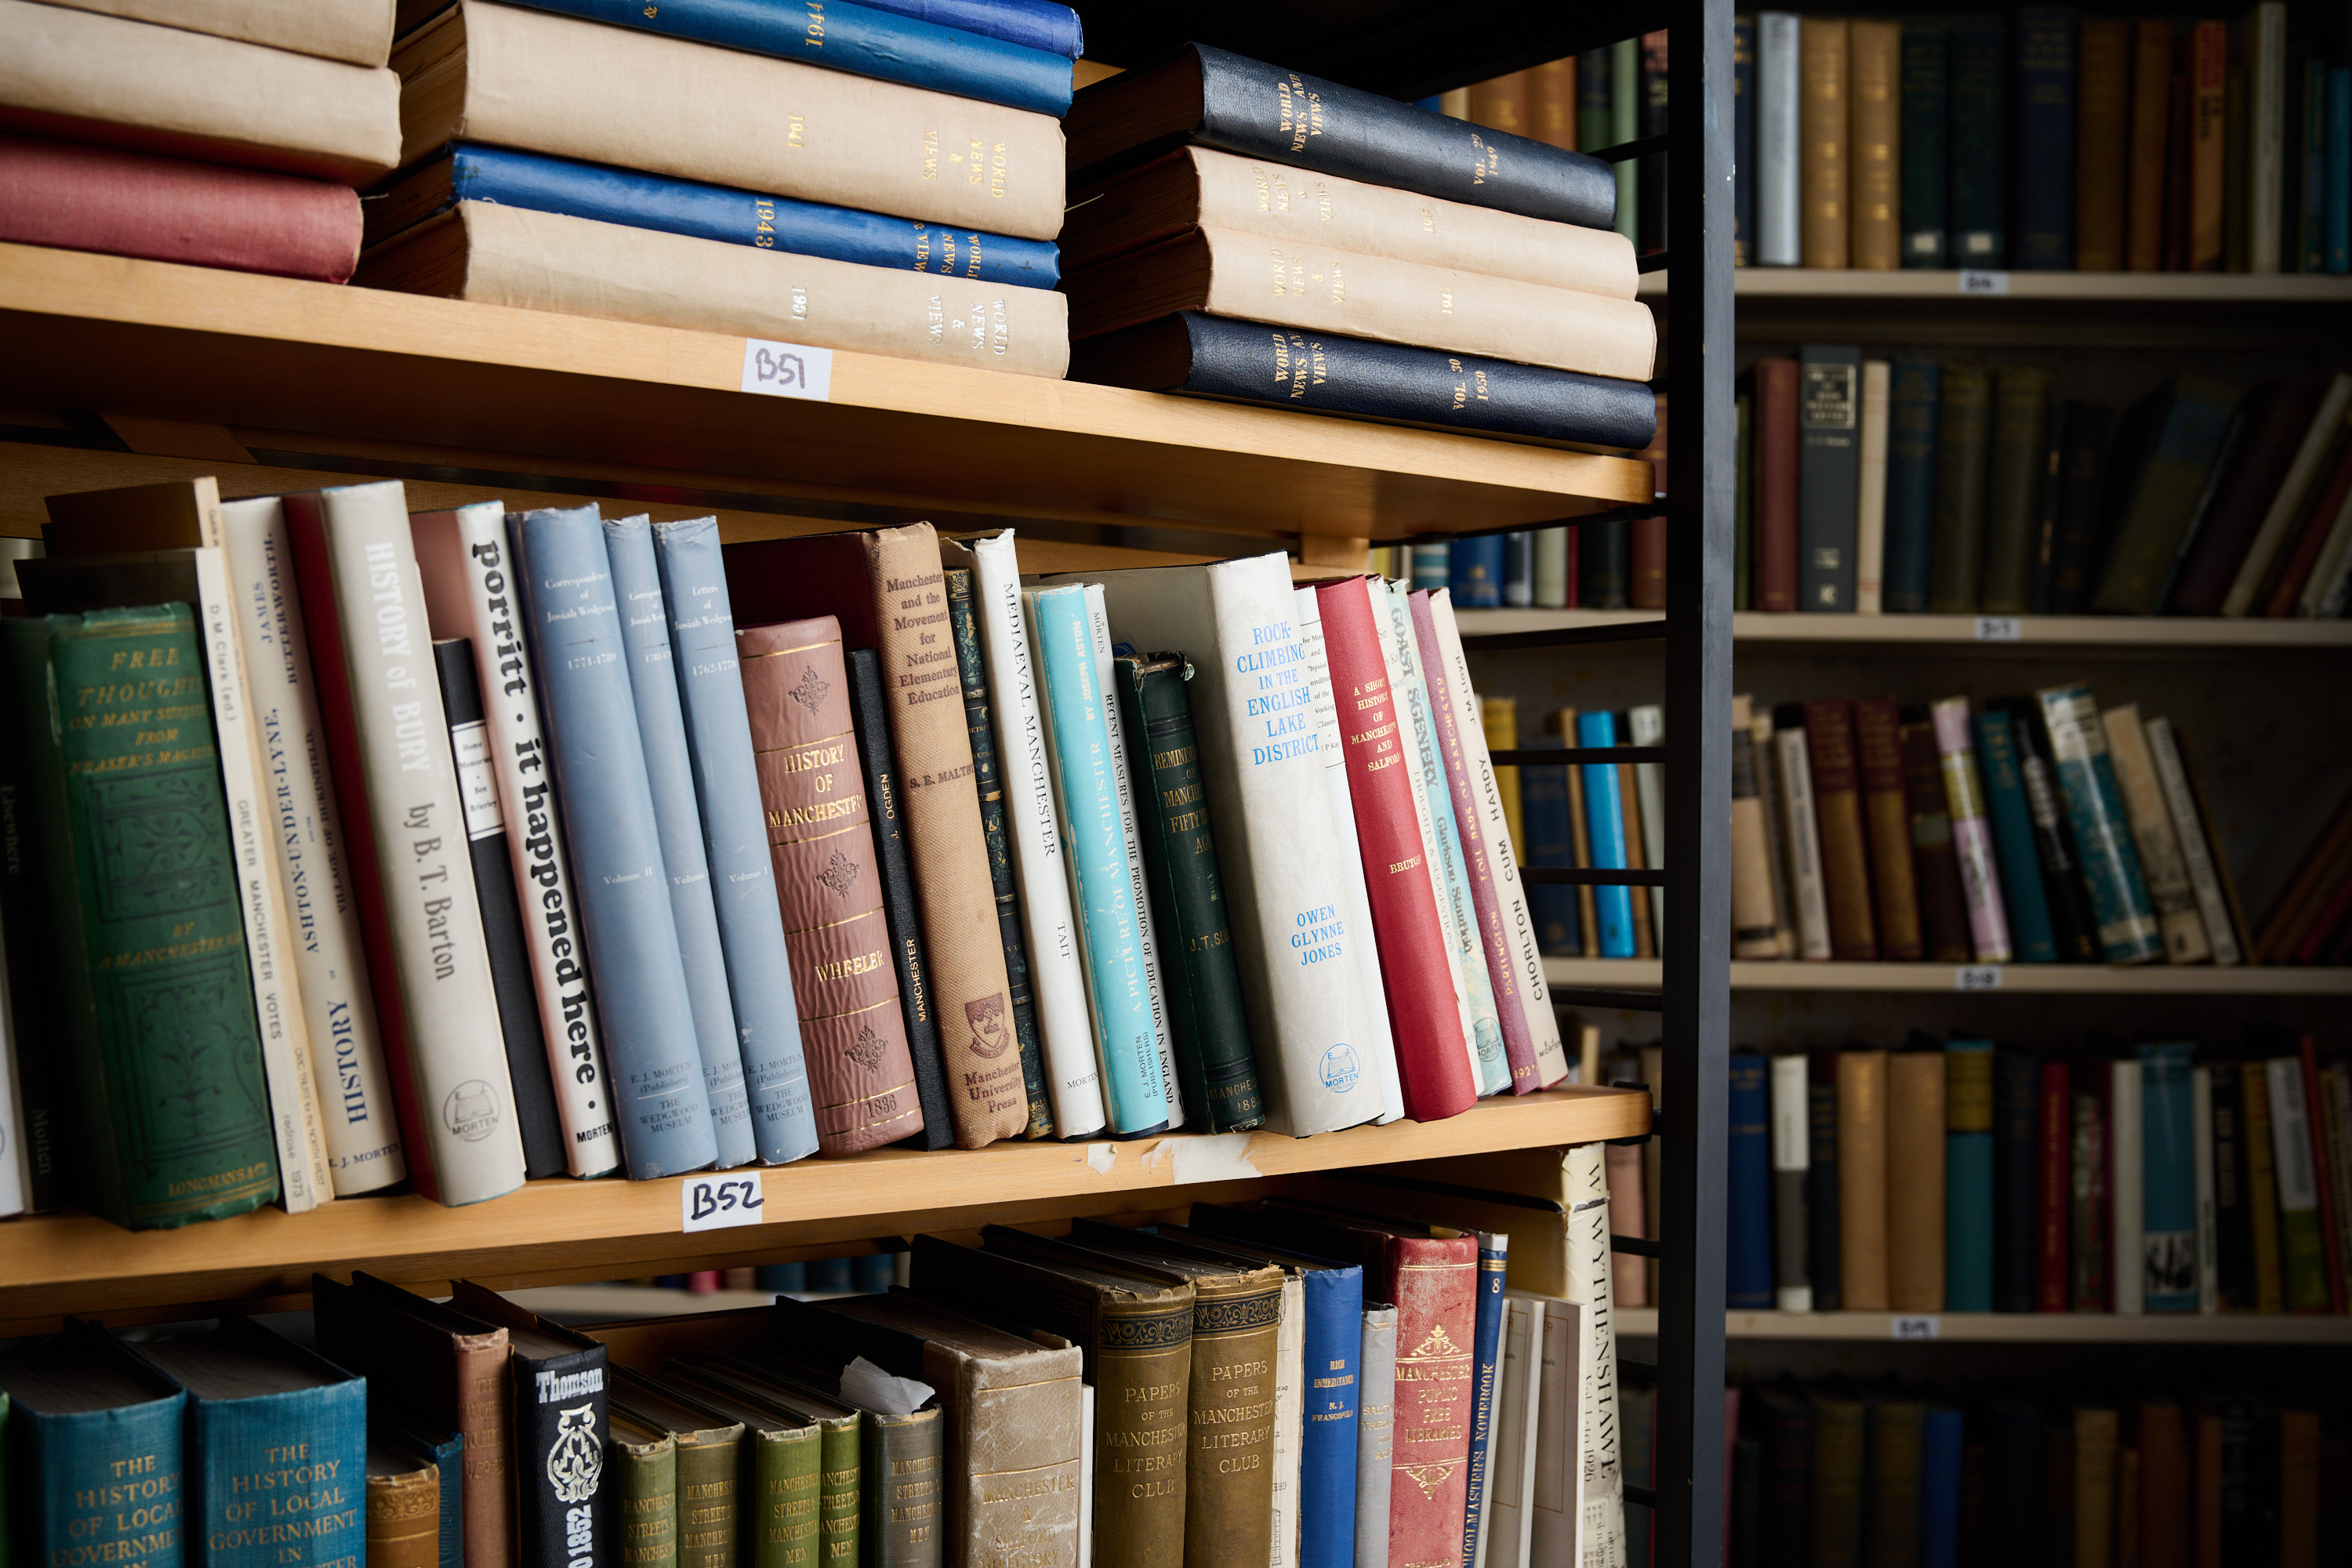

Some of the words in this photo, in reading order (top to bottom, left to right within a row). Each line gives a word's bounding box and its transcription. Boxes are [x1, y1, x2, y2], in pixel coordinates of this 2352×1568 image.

[805, 2, 826, 49] 1944
[1288, 72, 1306, 98] AND
[1279, 82, 1293, 132] WORLD
[1307, 92, 1322, 136] VIEWS
[1290, 112, 1308, 154] NEWS
[922, 130, 938, 182] VIEWS
[949, 152, 964, 163] &
[970, 138, 984, 186] NEWS
[991, 142, 1006, 199] WORLD
[1252, 165, 1272, 214] WORLD
[1277, 172, 1291, 212] NEWS
[755, 199, 775, 249] 1943
[940, 232, 956, 274] NEWS
[1271, 248, 1286, 297] WORLD
[1292, 255, 1306, 298] NEWS
[1311, 271, 1325, 282] &
[1332, 260, 1346, 305] VIEWS
[1440, 285, 1454, 314] 1947
[928, 295, 943, 347] VIEWS
[953, 319, 966, 329] &
[971, 302, 985, 350] NEWS
[992, 299, 1007, 355] WORLD
[755, 347, 806, 390] B51
[1274, 332, 1289, 383] WORLD
[1310, 342, 1327, 386] VIEWS
[1290, 358, 1308, 399] NEWS
[1475, 370, 1490, 401] 1950
[691, 585, 719, 597] Letters
[885, 572, 943, 593] Manchester
[252, 582, 272, 644] JAMES
[365, 541, 413, 657] HISTORY
[901, 596, 922, 610] and
[926, 591, 942, 605] the
[472, 540, 528, 699] porritt
[893, 609, 949, 631] Movement
[1093, 612, 1105, 655] MORTEN
[919, 631, 937, 646] for
[1073, 620, 1087, 658] ASTON
[1310, 648, 1321, 657] and
[110, 646, 180, 670] FREE
[692, 659, 737, 677] 1762-1770
[906, 648, 953, 667] National
[1236, 642, 1306, 674] CLIMBING
[386, 665, 418, 691] of
[898, 666, 959, 688] Elementary
[1078, 660, 1094, 702] JOSEPH
[1258, 675, 1273, 691] IN
[1275, 668, 1300, 687] THE
[1353, 686, 1361, 696] A
[907, 684, 961, 706] Education
[1247, 686, 1312, 717] ENGLISH
[1314, 691, 1321, 700] of
[1390, 606, 1416, 678] COAST
[1406, 686, 1440, 789] SCENERY
[100, 709, 153, 728] MANY
[1105, 693, 1120, 739] RECENT
[1266, 712, 1307, 739] LAKE
[1317, 717, 1336, 728] Classes
[1373, 710, 1384, 722] OF
[391, 701, 432, 774] BURY
[1253, 733, 1320, 766] DISTRICT
[1376, 739, 1393, 754] AND
[514, 737, 543, 776] it
[785, 744, 844, 775] HISTORY
[1003, 581, 1028, 709] MEDIAEVAL
[1024, 714, 1057, 857] MANCHESTER
[1056, 920, 1072, 960] TAIT
[815, 773, 834, 793] OF
[1112, 743, 1130, 806] MEASURES
[880, 772, 897, 819] OGDEN
[1089, 741, 1124, 880] MANCHESTER
[1123, 811, 1134, 834] FOR
[1169, 810, 1201, 834] FIFTY
[1126, 837, 1138, 863] THE
[1388, 853, 1422, 875] BRUTON
[1413, 768, 1435, 844] THOUGHTS
[1431, 861, 1455, 953] SUGGESTIONS
[1497, 838, 1515, 883] CUM
[522, 781, 583, 988] happened
[603, 871, 641, 886] Volume
[728, 869, 762, 884] Volume
[1436, 815, 1457, 884] Clarkson
[1450, 885, 1473, 955] Stanfield
[404, 802, 436, 829] by
[424, 896, 456, 982] Barton
[1112, 885, 1128, 910] OF
[1131, 866, 1150, 938] PROMOTION
[237, 799, 259, 867] GREATER
[249, 880, 273, 982] MANCHESTER
[265, 992, 282, 1040] VOTES
[1296, 903, 1337, 928] OWEN
[1142, 941, 1153, 958] OF
[1290, 921, 1345, 949] GLYNNE
[1300, 942, 1343, 967] JONES
[1489, 910, 1513, 996] PARTINGTON
[1512, 899, 1544, 1002] CHORLTON
[815, 949, 885, 983] WHEELER
[906, 938, 928, 1023] MANCHESTER
[1145, 961, 1163, 1029] EDUCATION
[561, 988, 596, 1086] here
[1156, 1032, 1167, 1046] IN
[328, 1000, 368, 1125] HISTORY
[768, 1052, 803, 1069] MORTEN
[1135, 1035, 1148, 1077] MORTEN
[1142, 1031, 1158, 1098] (PUBLISHERS)
[1159, 1049, 1175, 1105] ENGLAND
[1325, 1073, 1359, 1088] MORTEN
[755, 1093, 809, 1114] WEDGWOOD
[774, 1087, 794, 1100] THE
[864, 1094, 898, 1120] 1836
[987, 1098, 1018, 1114] Press
[766, 1105, 804, 1123] MUSEUM
[575, 1121, 614, 1144] MORTEN
[290, 1171, 305, 1198] 1973
[691, 1181, 764, 1220] B52
[1491, 1277, 1501, 1294] 8
[1589, 1214, 1619, 1480] WYTHENSHAWE
[1210, 1359, 1269, 1382] PAPERS
[1312, 1374, 1355, 1388] INHERITANCE
[1394, 1363, 1472, 1382] MANCHESTER
[535, 1367, 604, 1404] Thomson
[1123, 1381, 1181, 1403] PAPERS
[1225, 1388, 1240, 1399] OF
[1243, 1385, 1259, 1397] THE
[1141, 1411, 1156, 1422] OF
[1158, 1408, 1174, 1420] THE
[1193, 1399, 1274, 1426] MANCHESTER
[1311, 1409, 1354, 1422] FRANGOPULO
[1475, 1361, 1495, 1443] NOTEBOOK
[1105, 1422, 1187, 1449] MANCHESTER
[1201, 1425, 1271, 1450] LITERARY
[1405, 1424, 1463, 1443] LIBRARIES
[110, 1454, 157, 1479] THE
[265, 1443, 311, 1465] THE
[1112, 1449, 1184, 1474] LITERARY
[1218, 1454, 1261, 1475] CLUB
[1584, 1449, 1596, 1483] 1926
[231, 1459, 341, 1494] HISTORY
[982, 1472, 1076, 1505] MANCHESTER
[1131, 1478, 1176, 1500] CLUB
[225, 1501, 257, 1523] OF
[271, 1486, 346, 1517] LOCAL
[68, 1515, 103, 1539] OF
[209, 1508, 358, 1552] GOVERNMENT
[565, 1504, 593, 1552] 1852
[278, 1544, 303, 1565] IN
[786, 1548, 809, 1565] MEN
[830, 1541, 853, 1559] MEN
